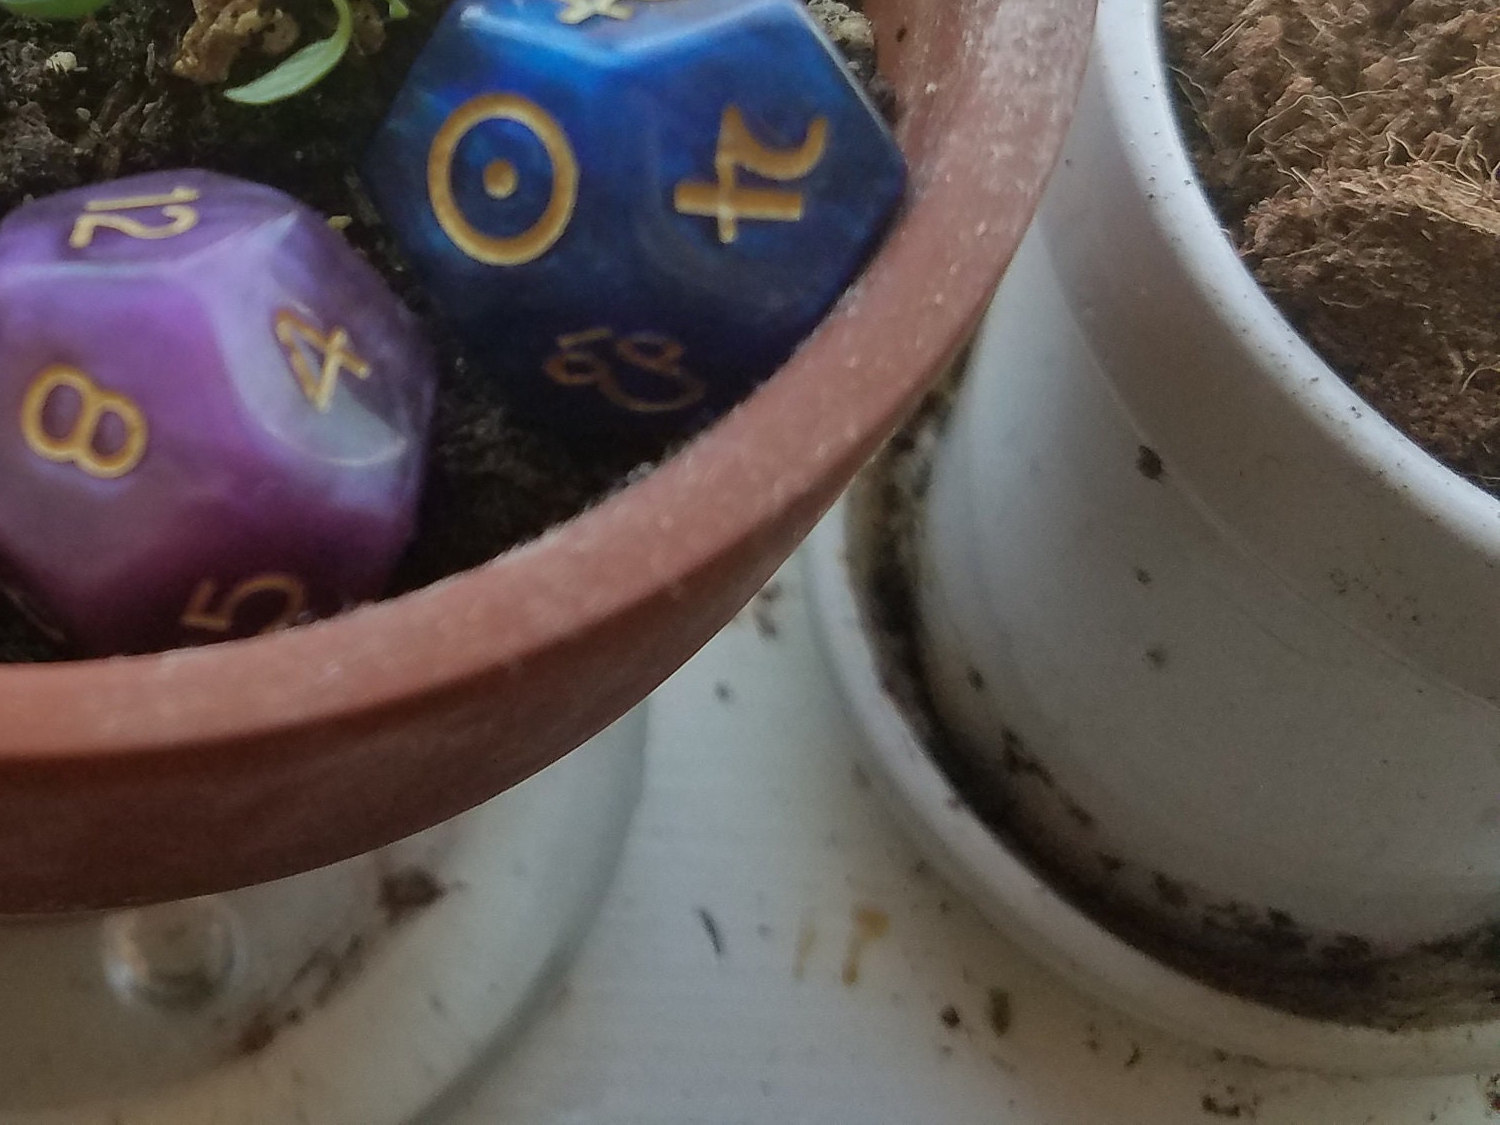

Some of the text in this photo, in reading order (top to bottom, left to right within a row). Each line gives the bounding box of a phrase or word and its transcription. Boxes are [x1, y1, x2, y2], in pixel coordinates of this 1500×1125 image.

[274, 309, 372, 412] 4
[22, 365, 149, 479] 8
[181, 574, 309, 633] 5
